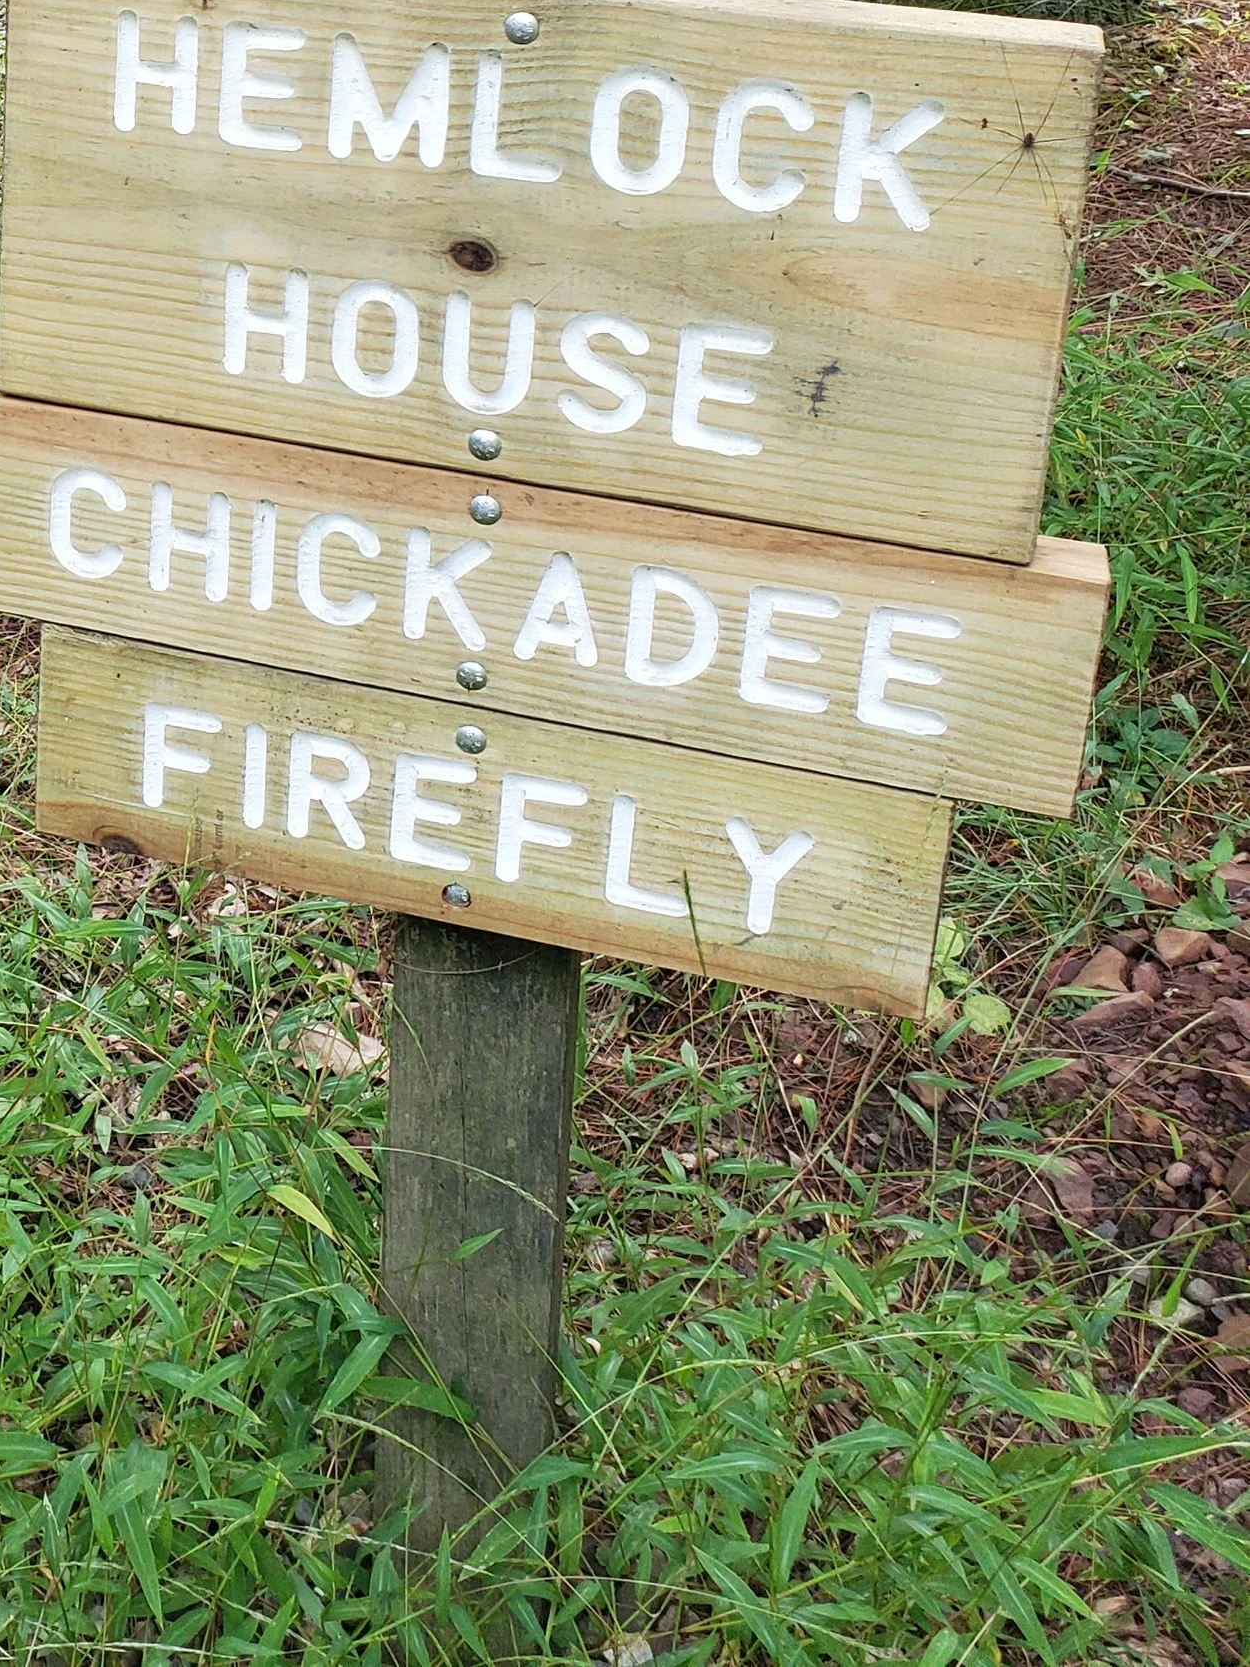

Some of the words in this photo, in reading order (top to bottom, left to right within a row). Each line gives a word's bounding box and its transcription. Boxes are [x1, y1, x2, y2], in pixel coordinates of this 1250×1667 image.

[114, 10, 945, 232] HEMLOCK
[223, 262, 774, 456] HOUSE
[49, 467, 961, 737] CHICKADEE
[142, 703, 814, 935] FIREFLY
